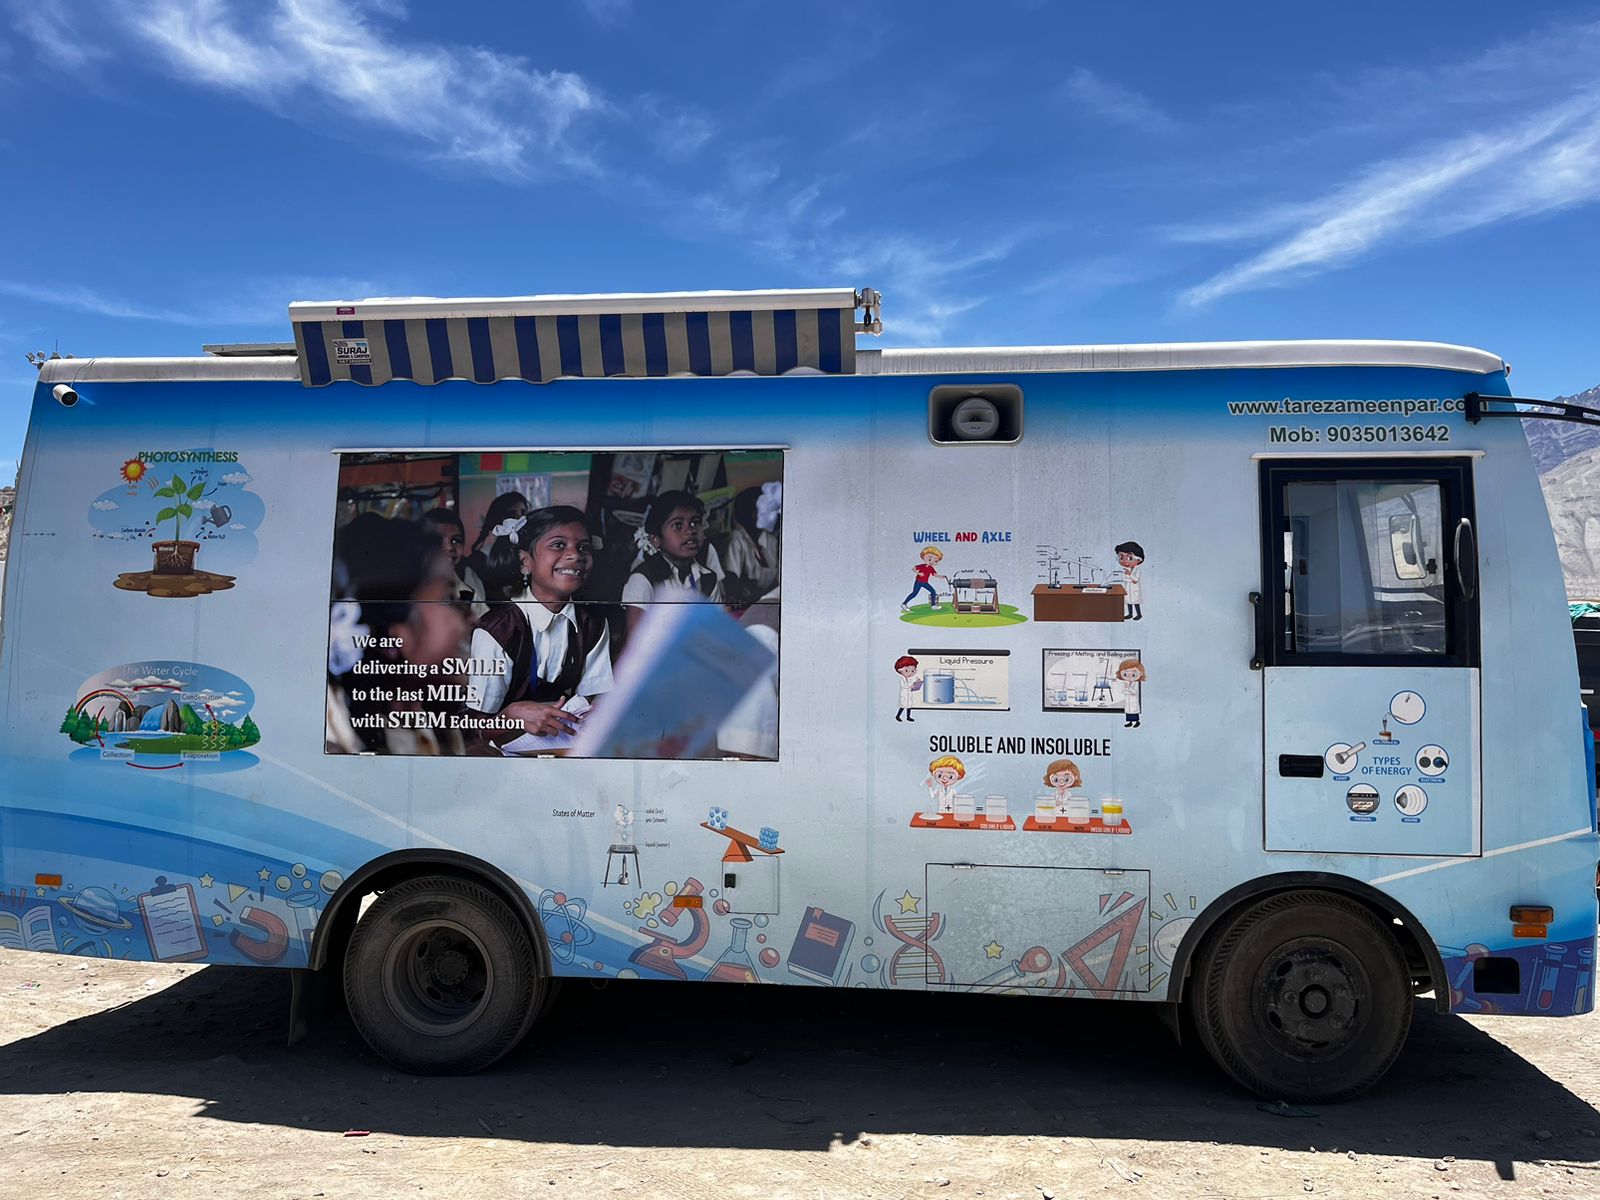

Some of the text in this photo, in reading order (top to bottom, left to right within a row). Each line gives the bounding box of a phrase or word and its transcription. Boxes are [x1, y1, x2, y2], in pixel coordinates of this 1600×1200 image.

[337, 346, 368, 354] SURAJ
[1270, 426, 1450, 443] Mob: 9035013642
[138, 451, 239, 463] PHOTOSYNTHESIS
[913, 531, 1012, 543] WHEEL AND AXLE
[353, 634, 403, 648] We are
[939, 656, 994, 665] Liquid Pressure
[142, 666, 169, 675] Water
[172, 666, 198, 677] Cycle
[353, 657, 507, 677] delivering a SMILE
[181, 693, 223, 701] Condensation
[352, 689, 366, 702] to
[370, 686, 394, 701] the
[397, 687, 423, 701] last
[351, 711, 525, 730] with STEM Education
[929, 735, 1111, 756] SOLUBLE AND INSOLUBLE
[183, 752, 218, 760] Evaporation
[1373, 757, 1400, 765] TYPES
[1361, 766, 1411, 775] OF ENERGY
[552, 809, 569, 817] States
